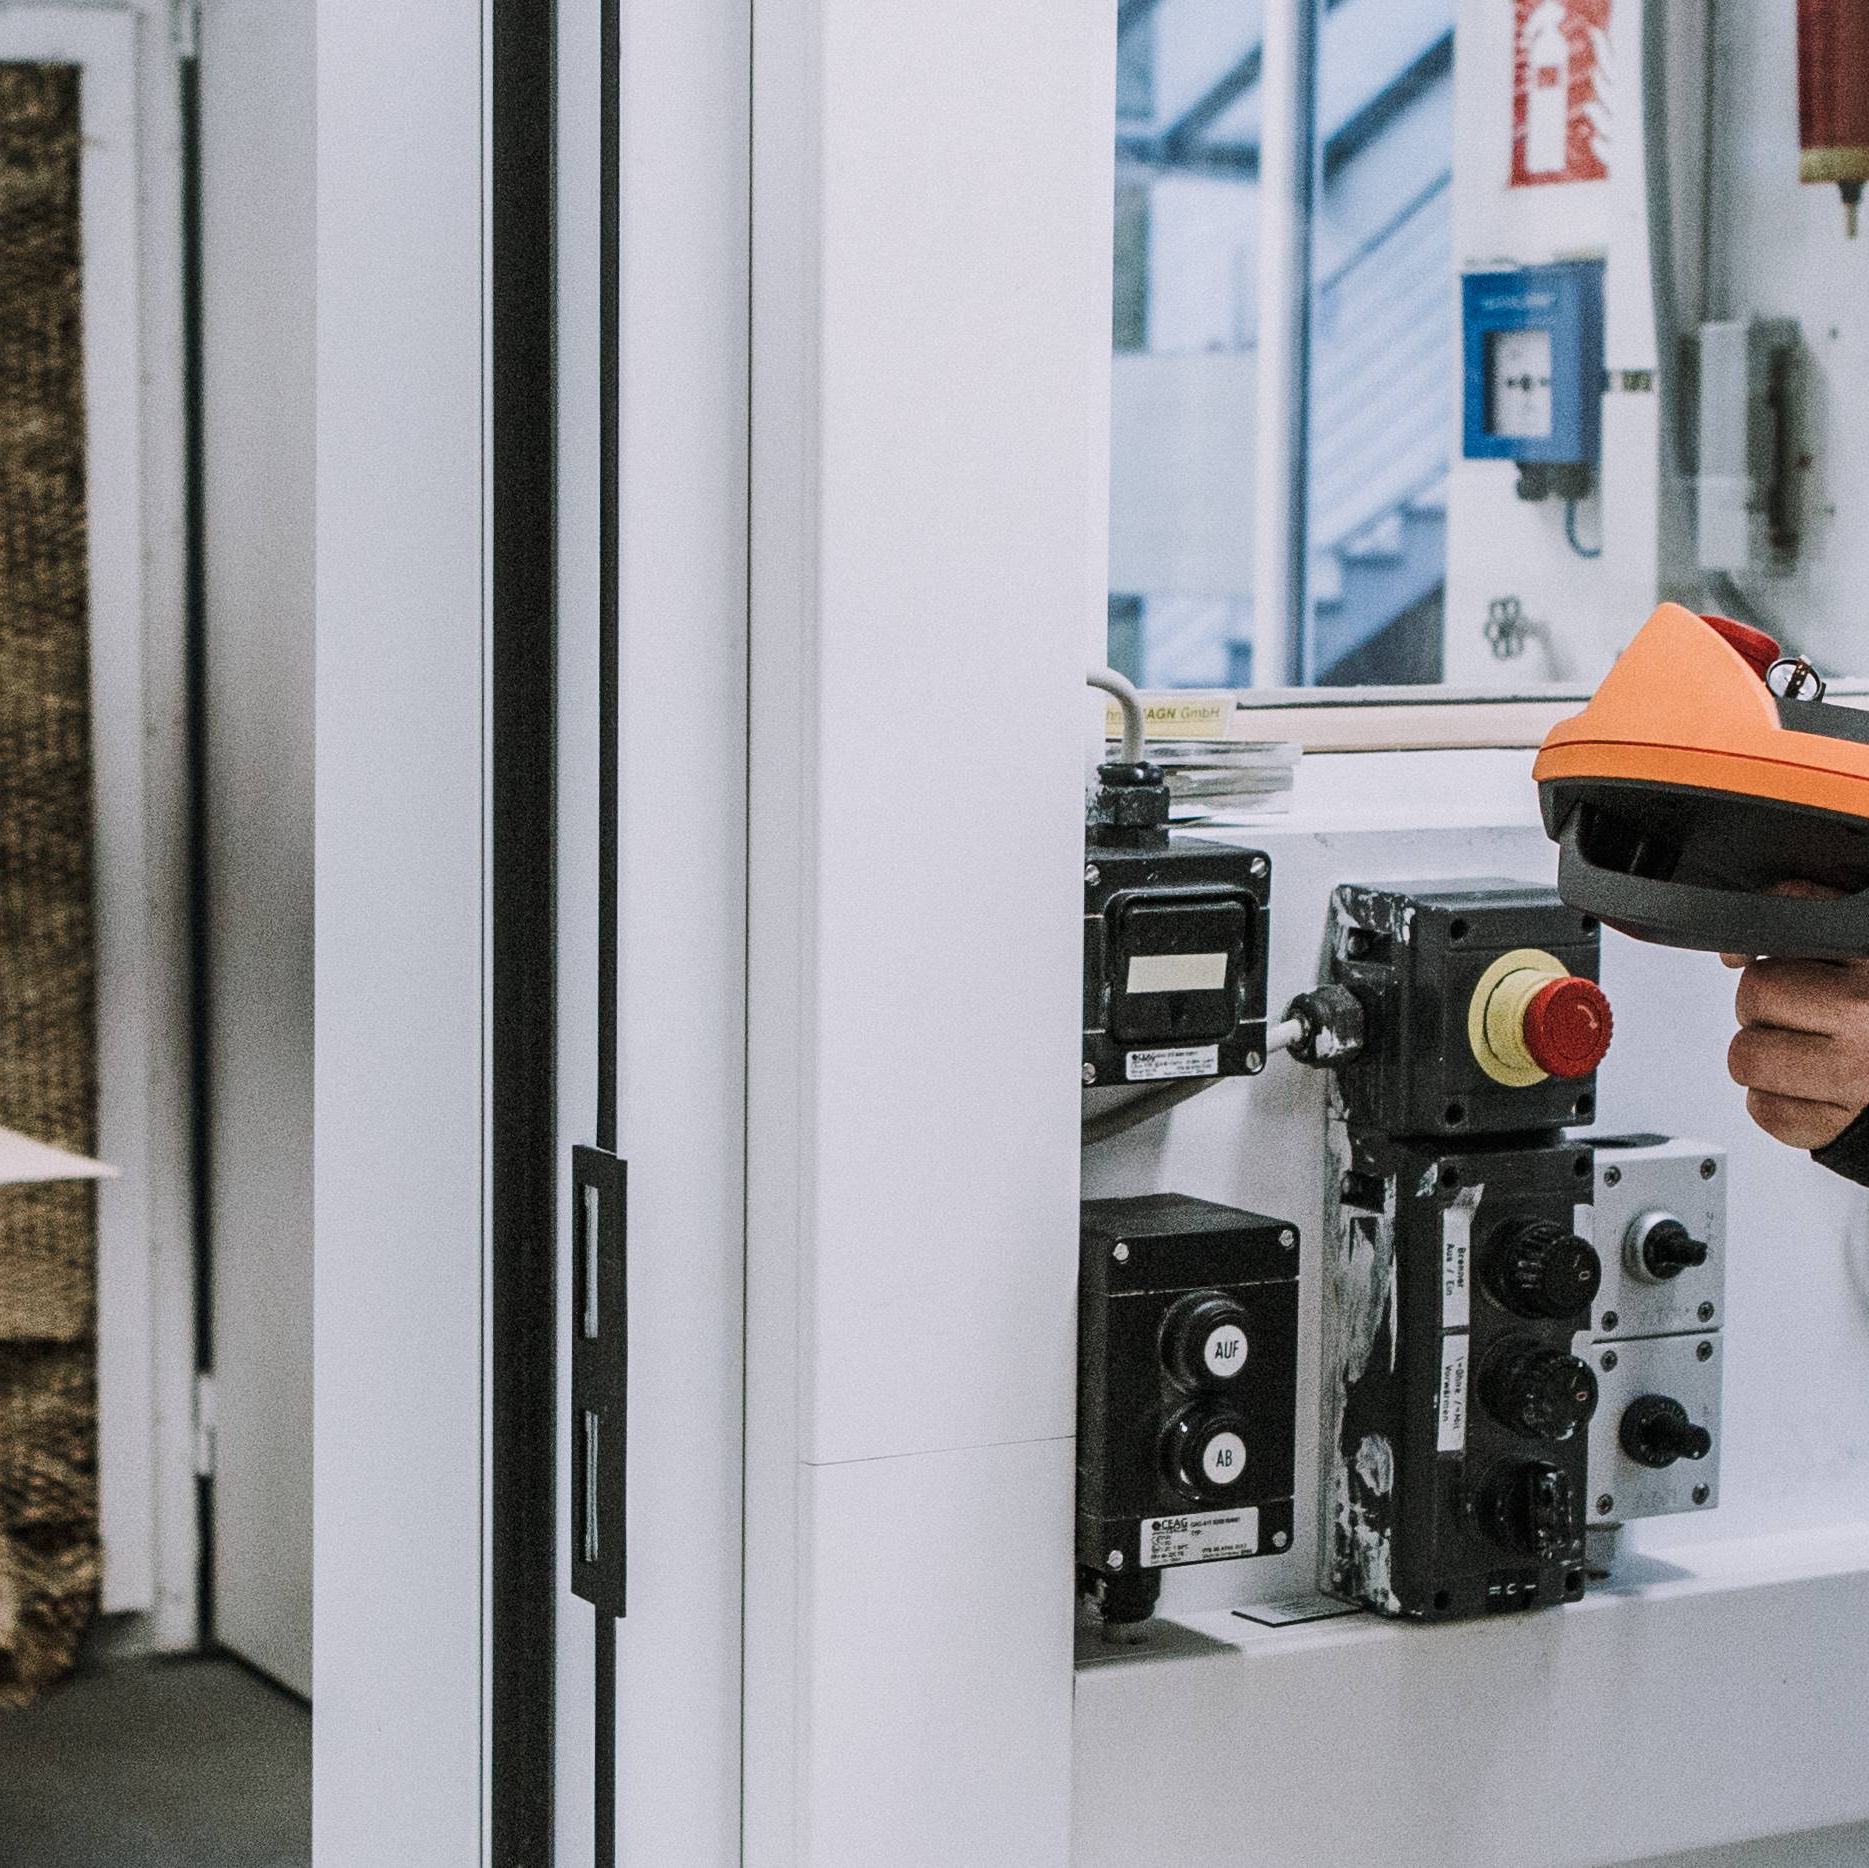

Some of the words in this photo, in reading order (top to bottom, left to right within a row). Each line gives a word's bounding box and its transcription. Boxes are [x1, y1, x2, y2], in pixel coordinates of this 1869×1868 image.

[1180, 706, 1221, 720] GmbH
[1215, 1340, 1240, 1359] AUF
[1216, 1449, 1233, 1467] AB
